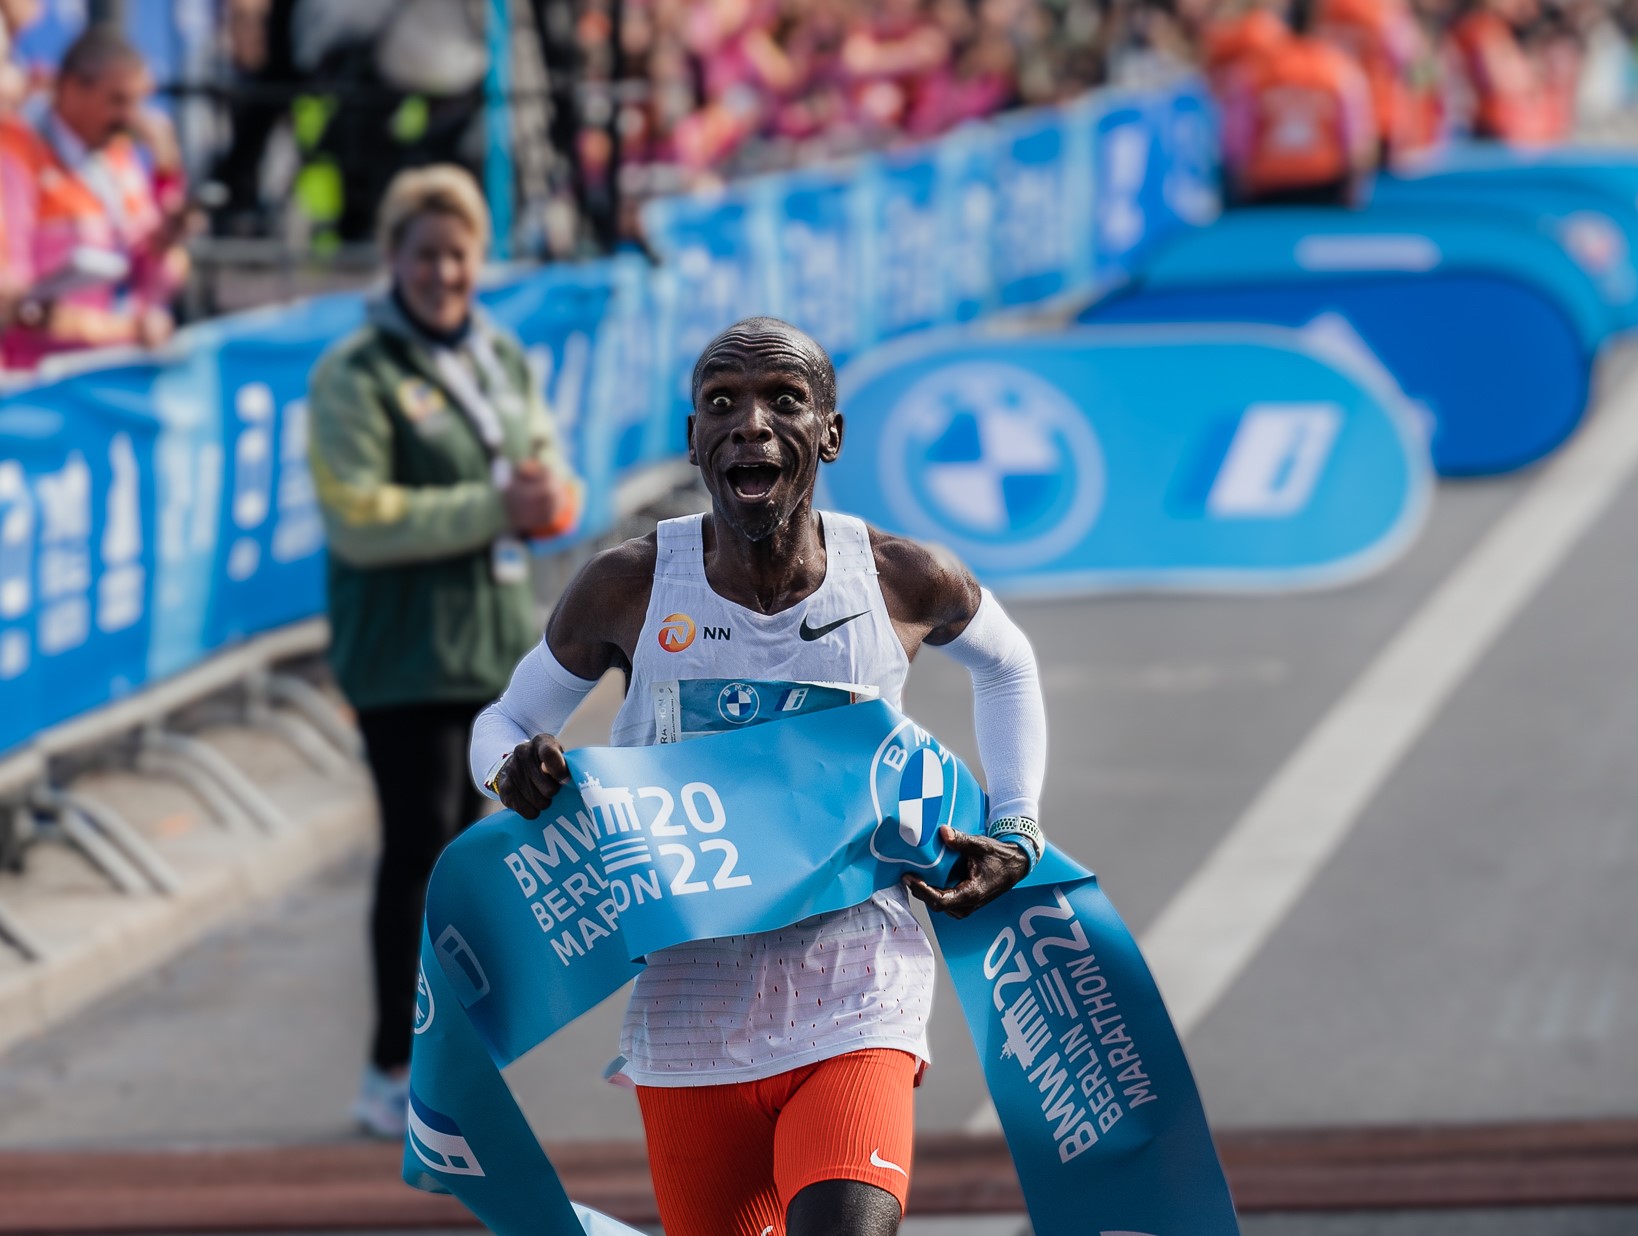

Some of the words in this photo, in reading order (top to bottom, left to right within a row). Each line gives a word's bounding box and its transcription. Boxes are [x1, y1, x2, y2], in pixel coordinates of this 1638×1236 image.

[703, 626, 731, 640] NN
[723, 684, 753, 697] BMW
[637, 781, 727, 837] 20
[503, 808, 602, 899] BMW
[658, 838, 753, 896] 22
[530, 862, 610, 933] BERL
[1019, 886, 1090, 967] 22
[983, 926, 1032, 1012] 20
[1066, 954, 1158, 1108] MARATHON
[1027, 1051, 1099, 1164] BMW
[1059, 1022, 1123, 1134] BERLIN
